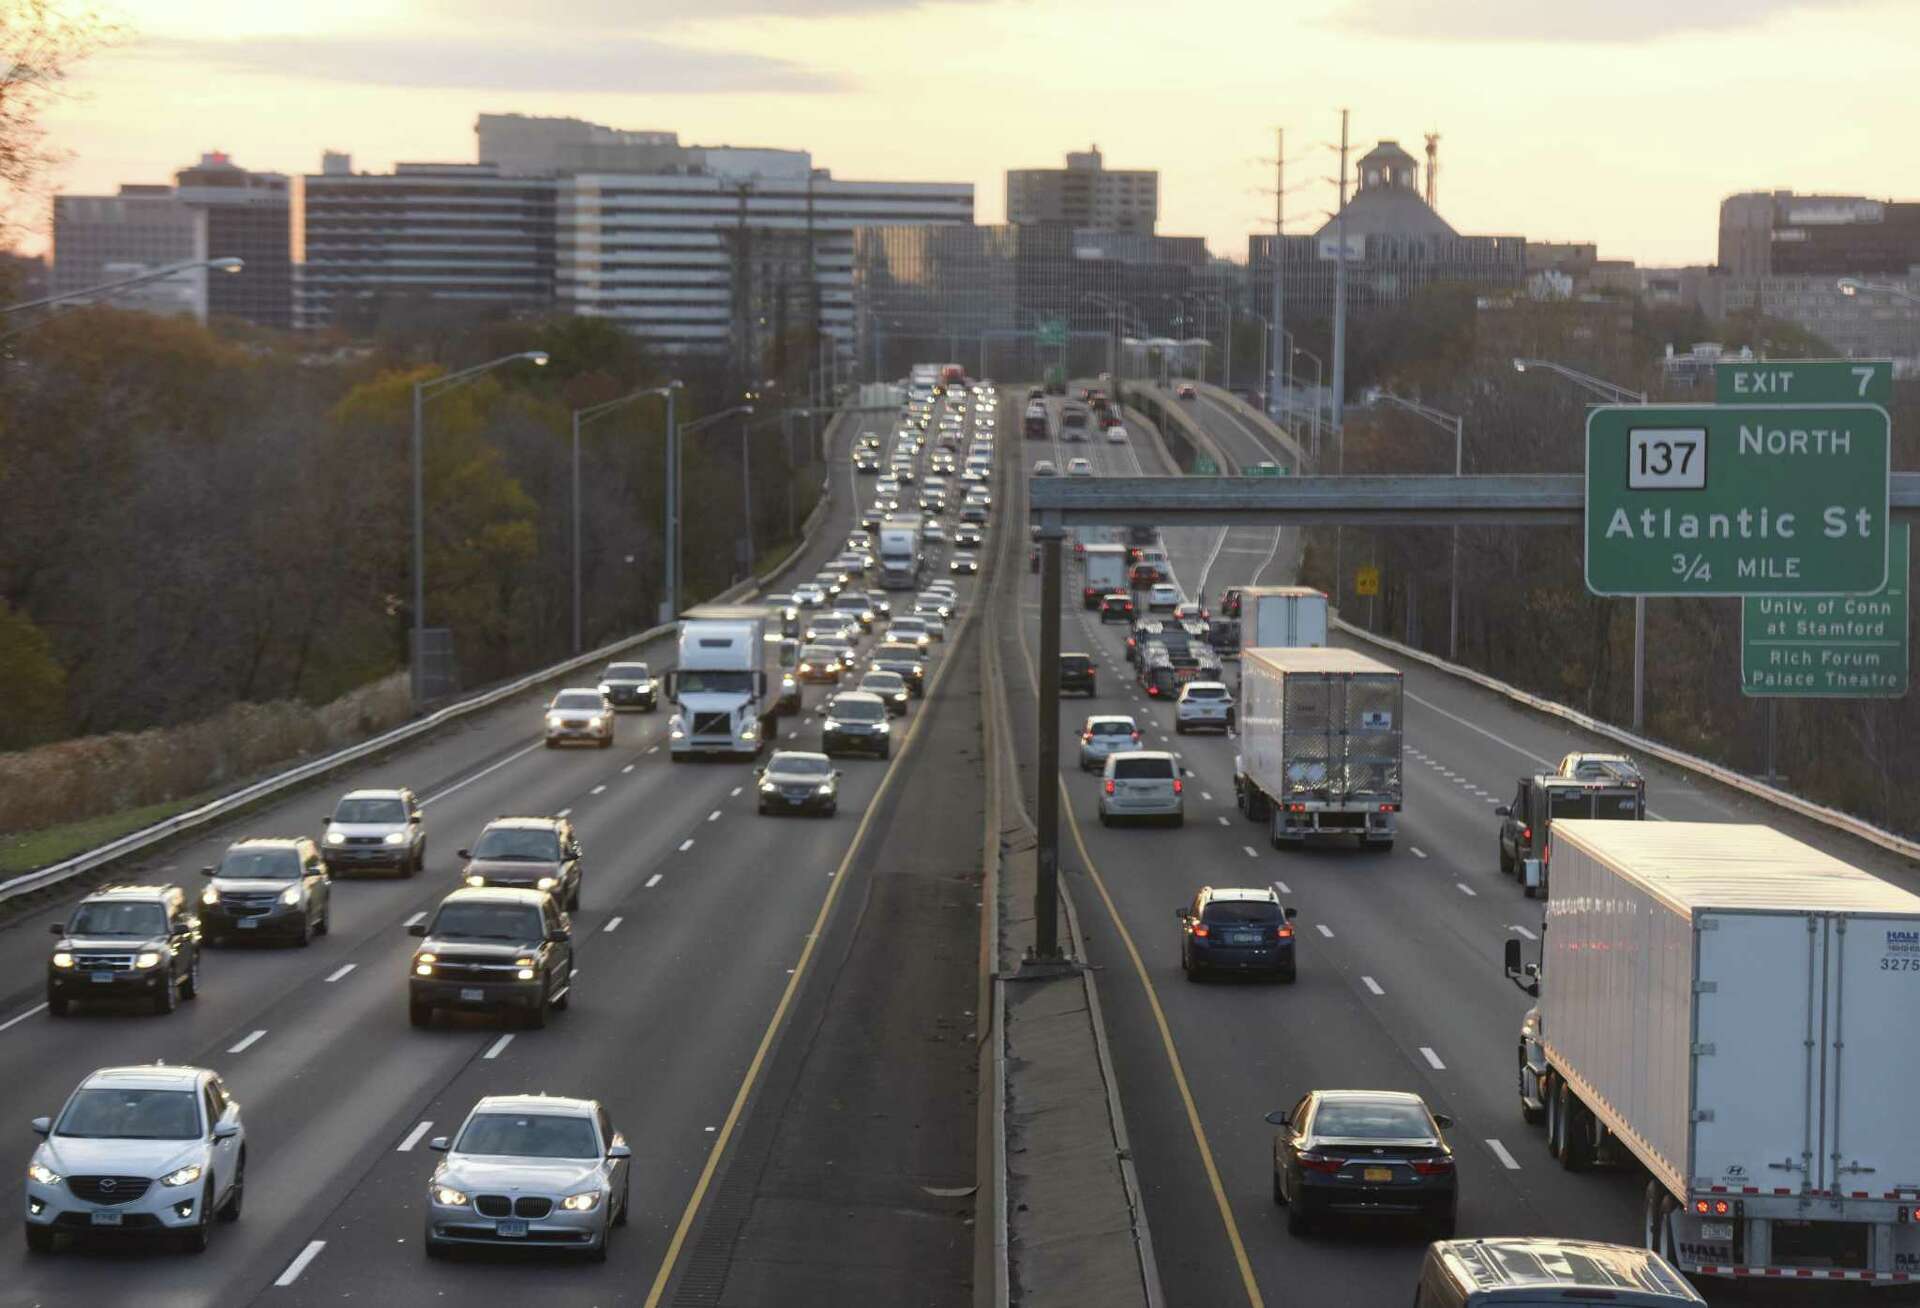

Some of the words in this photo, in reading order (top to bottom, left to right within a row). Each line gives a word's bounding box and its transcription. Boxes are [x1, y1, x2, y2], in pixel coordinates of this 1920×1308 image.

[1734, 372, 1794, 394] EXIT
[1851, 366, 1875, 397] 7
[1739, 425, 1850, 455] NORTH
[1638, 442, 1697, 475] 137
[1605, 507, 1796, 539] Atlantic
[1823, 505, 1872, 538] St
[1671, 552, 1712, 582] 3/4
[1737, 556, 1800, 579] MILE
[1760, 599, 1807, 615] Univ.
[1817, 601, 1834, 614] of
[1844, 600, 1892, 615] Conn
[1767, 622, 1786, 635] at
[1796, 620, 1885, 636] Stamford
[1770, 650, 1812, 666] Rich
[1821, 651, 1881, 666] Forum
[1752, 669, 1816, 687] Palace
[1825, 671, 1898, 687] Theatre
